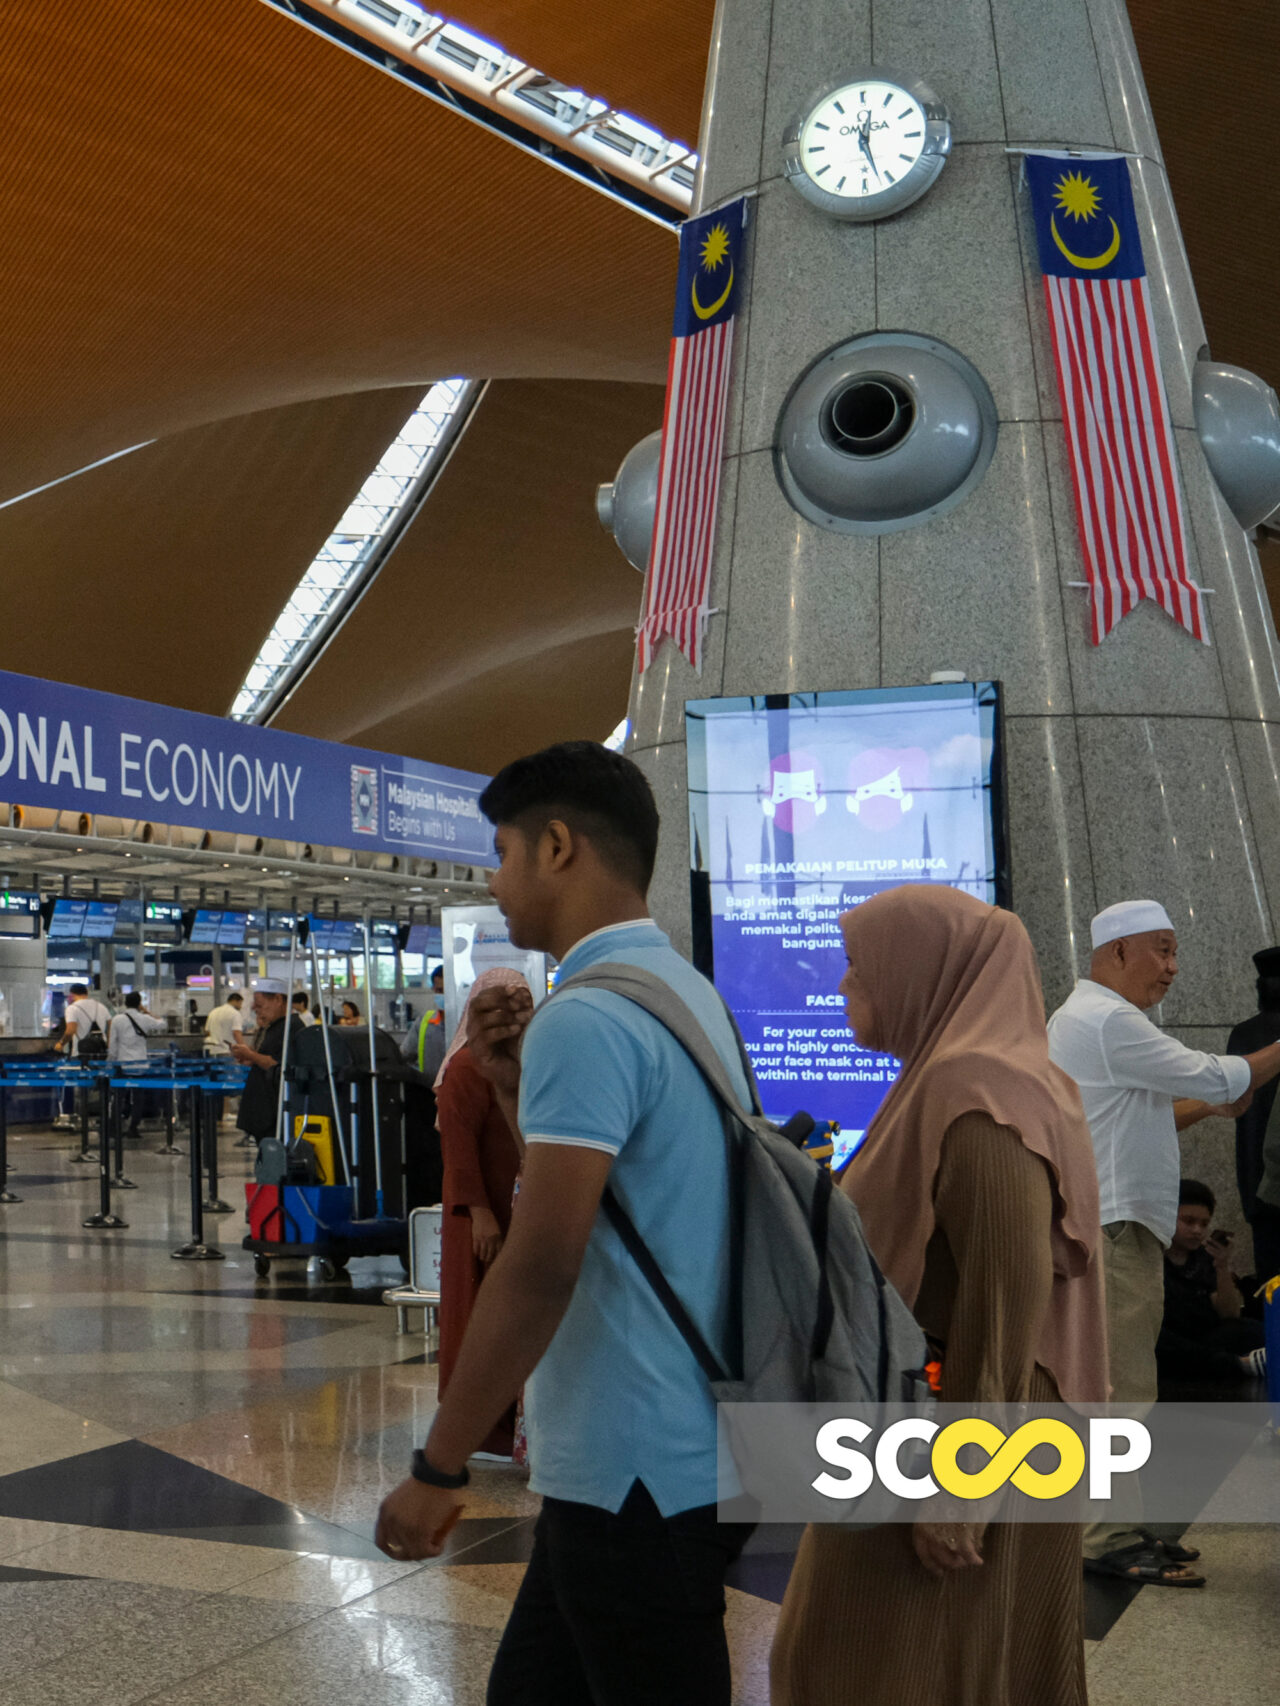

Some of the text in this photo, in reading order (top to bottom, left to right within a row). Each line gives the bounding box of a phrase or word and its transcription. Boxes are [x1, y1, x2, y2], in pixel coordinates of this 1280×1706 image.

[839, 120, 890, 136] OMGA
[120, 732, 302, 821] ECONOMY
[388, 782, 435, 810] Malaysian
[388, 810, 421, 837] Begins
[745, 858, 948, 875] PEMAKAIAN PELITUP MUKA
[725, 895, 756, 908] Bagi
[758, 894, 839, 906] memastikan
[723, 908, 849, 922] anda amat digala
[741, 923, 841, 936] memakai pelitu
[782, 938, 844, 949] banguna
[806, 995, 845, 1006] FACE
[763, 1027, 853, 1039] For your cont
[744, 1041, 872, 1054] ou are highly enc
[751, 1056, 901, 1068] your face mask on at a
[756, 1069, 898, 1081] within the terminal b
